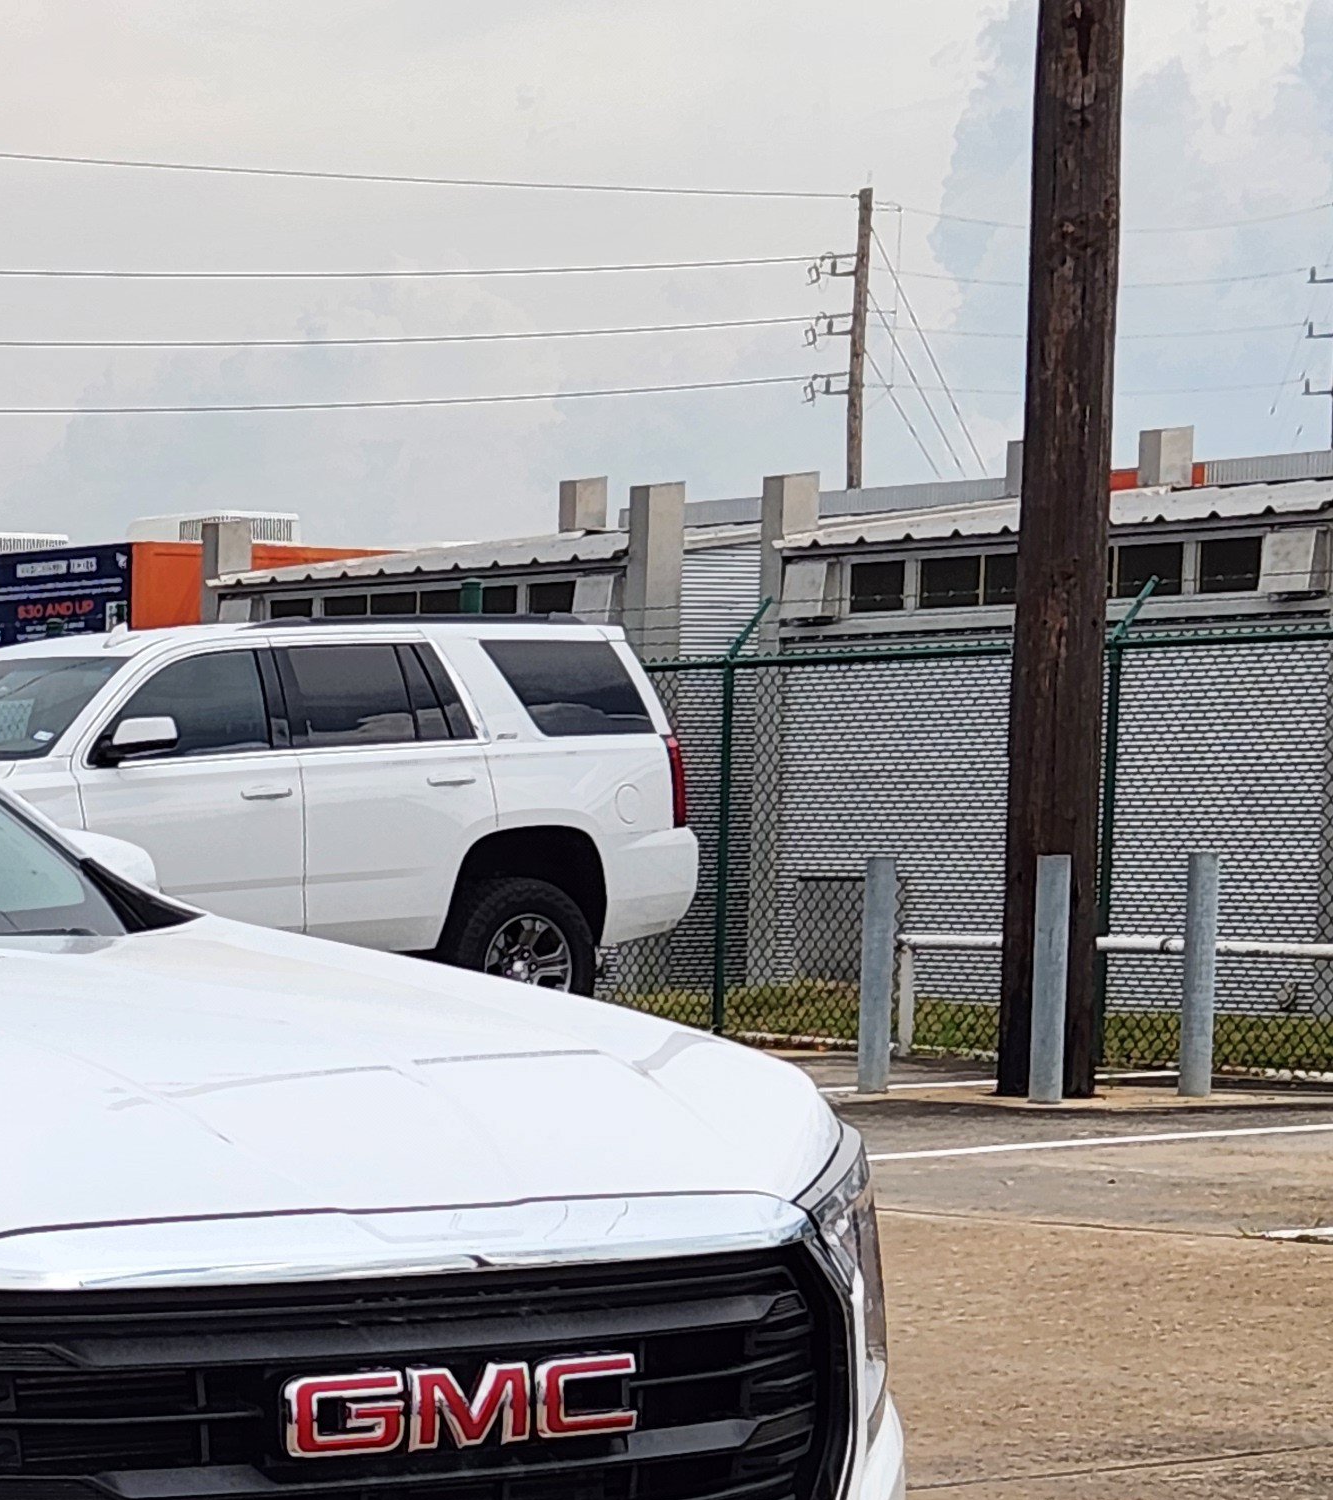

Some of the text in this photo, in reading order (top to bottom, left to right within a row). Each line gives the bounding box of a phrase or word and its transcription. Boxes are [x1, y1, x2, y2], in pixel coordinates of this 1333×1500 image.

[45, 601, 73, 616] AND
[75, 599, 95, 614] UP
[283, 1352, 638, 1459] GMC
